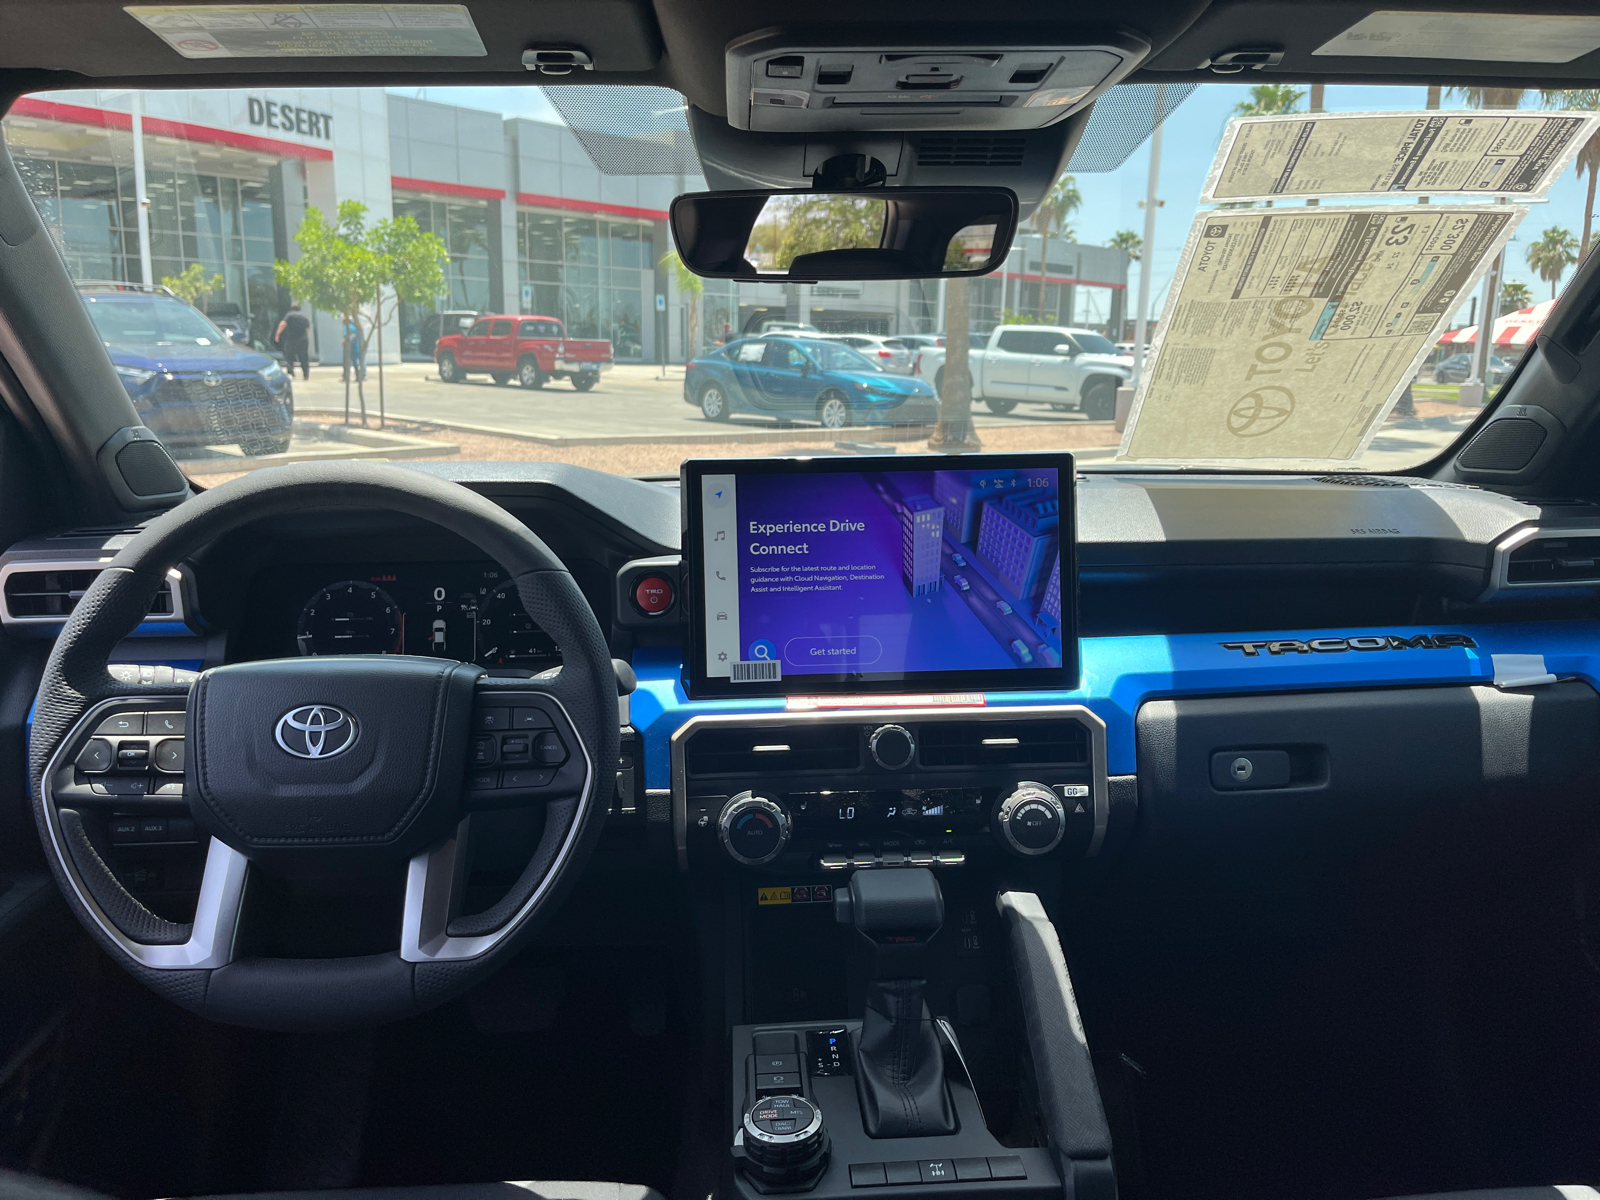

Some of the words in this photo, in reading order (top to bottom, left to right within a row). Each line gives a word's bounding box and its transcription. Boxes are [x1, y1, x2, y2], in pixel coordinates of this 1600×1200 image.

[247, 97, 333, 140] DESERT
[1295, 341, 1331, 373] Let's
[1027, 478, 1049, 488] 1:06
[749, 520, 826, 536] Experience
[829, 519, 866, 532] Drive
[750, 542, 809, 555] Connect
[751, 576, 779, 584] guidance
[814, 574, 849, 582] Navigation,
[347, 586, 353, 594] 4
[433, 587, 446, 601] 0
[782, 585, 814, 593] Intelligent
[370, 591, 376, 599] 5
[390, 627, 395, 635] 7
[1216, 634, 1480, 657] TACOMA
[810, 648, 826, 656] Get
[827, 647, 857, 656] started
[1067, 788, 1078, 796] GG
[838, 807, 855, 820] LO
